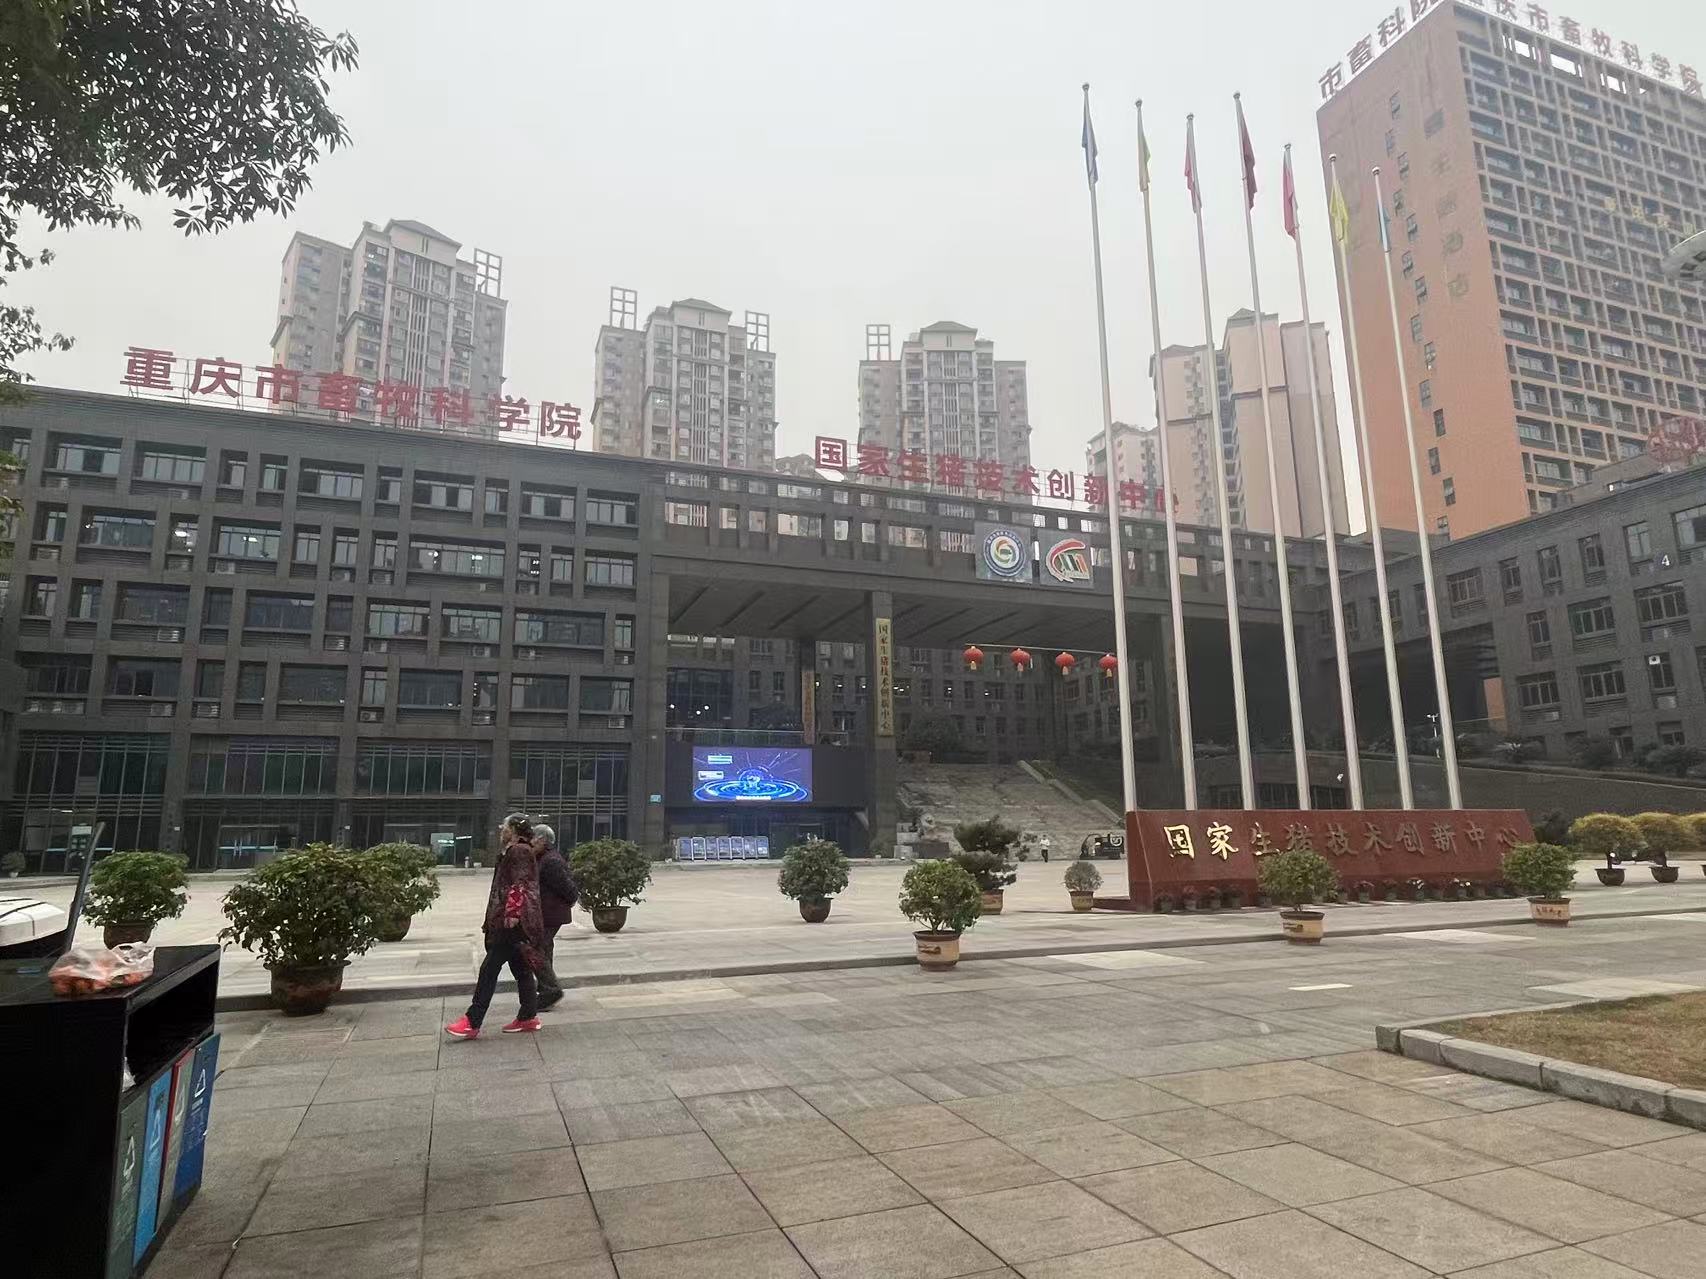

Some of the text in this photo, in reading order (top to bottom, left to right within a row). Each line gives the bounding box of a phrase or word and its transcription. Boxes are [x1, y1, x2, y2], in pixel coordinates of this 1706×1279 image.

[119, 346, 582, 440] 重庆市畜牧科学院
[1163, 821, 1523, 861] 国家生猪技术创新中心
